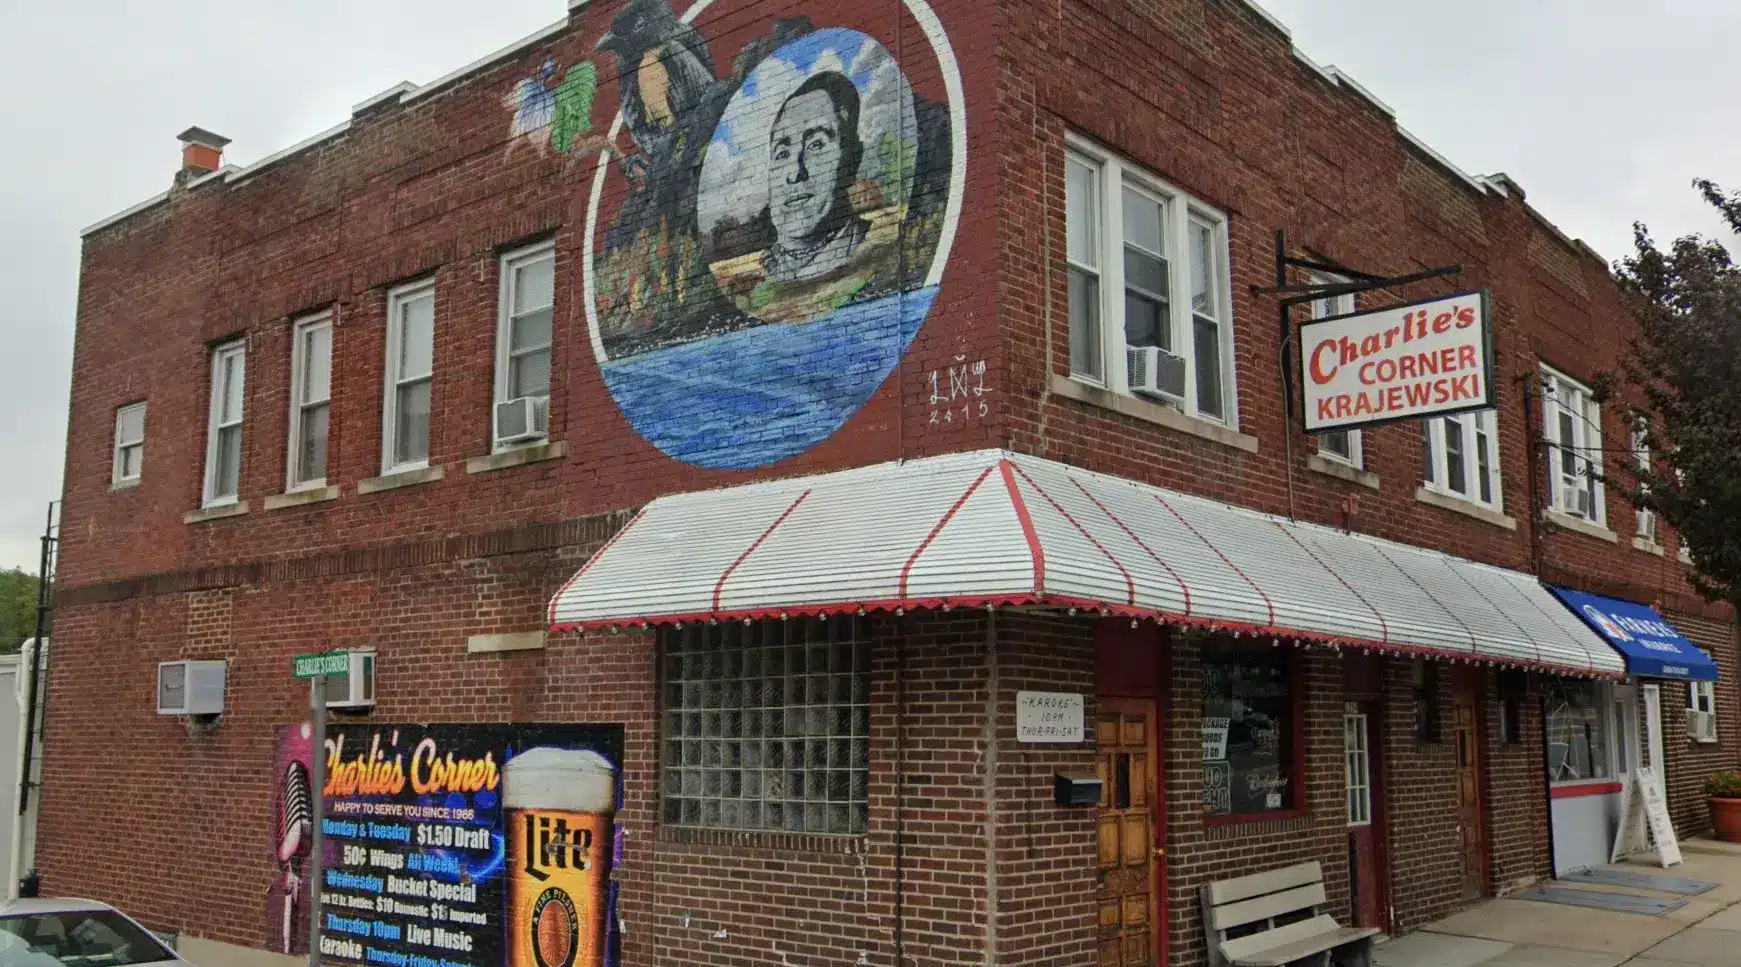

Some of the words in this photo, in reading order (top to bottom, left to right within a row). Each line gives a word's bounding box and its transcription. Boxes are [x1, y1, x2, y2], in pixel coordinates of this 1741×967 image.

[1310, 304, 1476, 384] Charlie's
[1359, 344, 1478, 385] CORNER
[1318, 373, 1480, 421] KRAJEWSKI
[296, 657, 324, 676] CHARLIE'S
[325, 654, 348, 672] CORNER
[1202, 718, 1228, 728] ACKAGE
[411, 738, 500, 794] Corner
[334, 801, 361, 812] HAPPY
[362, 803, 374, 814] TO
[375, 804, 402, 815] SERVE
[404, 805, 421, 817] YOU
[423, 806, 450, 819] SINCE
[359, 824, 366, 837] &
[368, 822, 411, 842] Tuesday
[417, 822, 452, 846] $1.50
[455, 826, 490, 850] Draft
[524, 814, 592, 881] Lite
[344, 845, 366, 866] 50¢
[370, 849, 404, 869] Wings
[407, 853, 421, 870] All
[327, 869, 384, 892] Wednesday
[387, 875, 428, 897] Bucket
[430, 879, 476, 902] Special
[320, 892, 330, 904] ive
[332, 894, 338, 905] 12
[376, 896, 394, 913] $10
[394, 902, 429, 917] Domestic
[431, 902, 448, 920] $15
[450, 909, 486, 925] Imported
[536, 890, 552, 912] FINE
[553, 889, 577, 930] PILSNER
[327, 912, 370, 936] Thursday
[373, 920, 400, 939] 10pm
[407, 924, 431, 946] Live
[433, 927, 472, 951] Music
